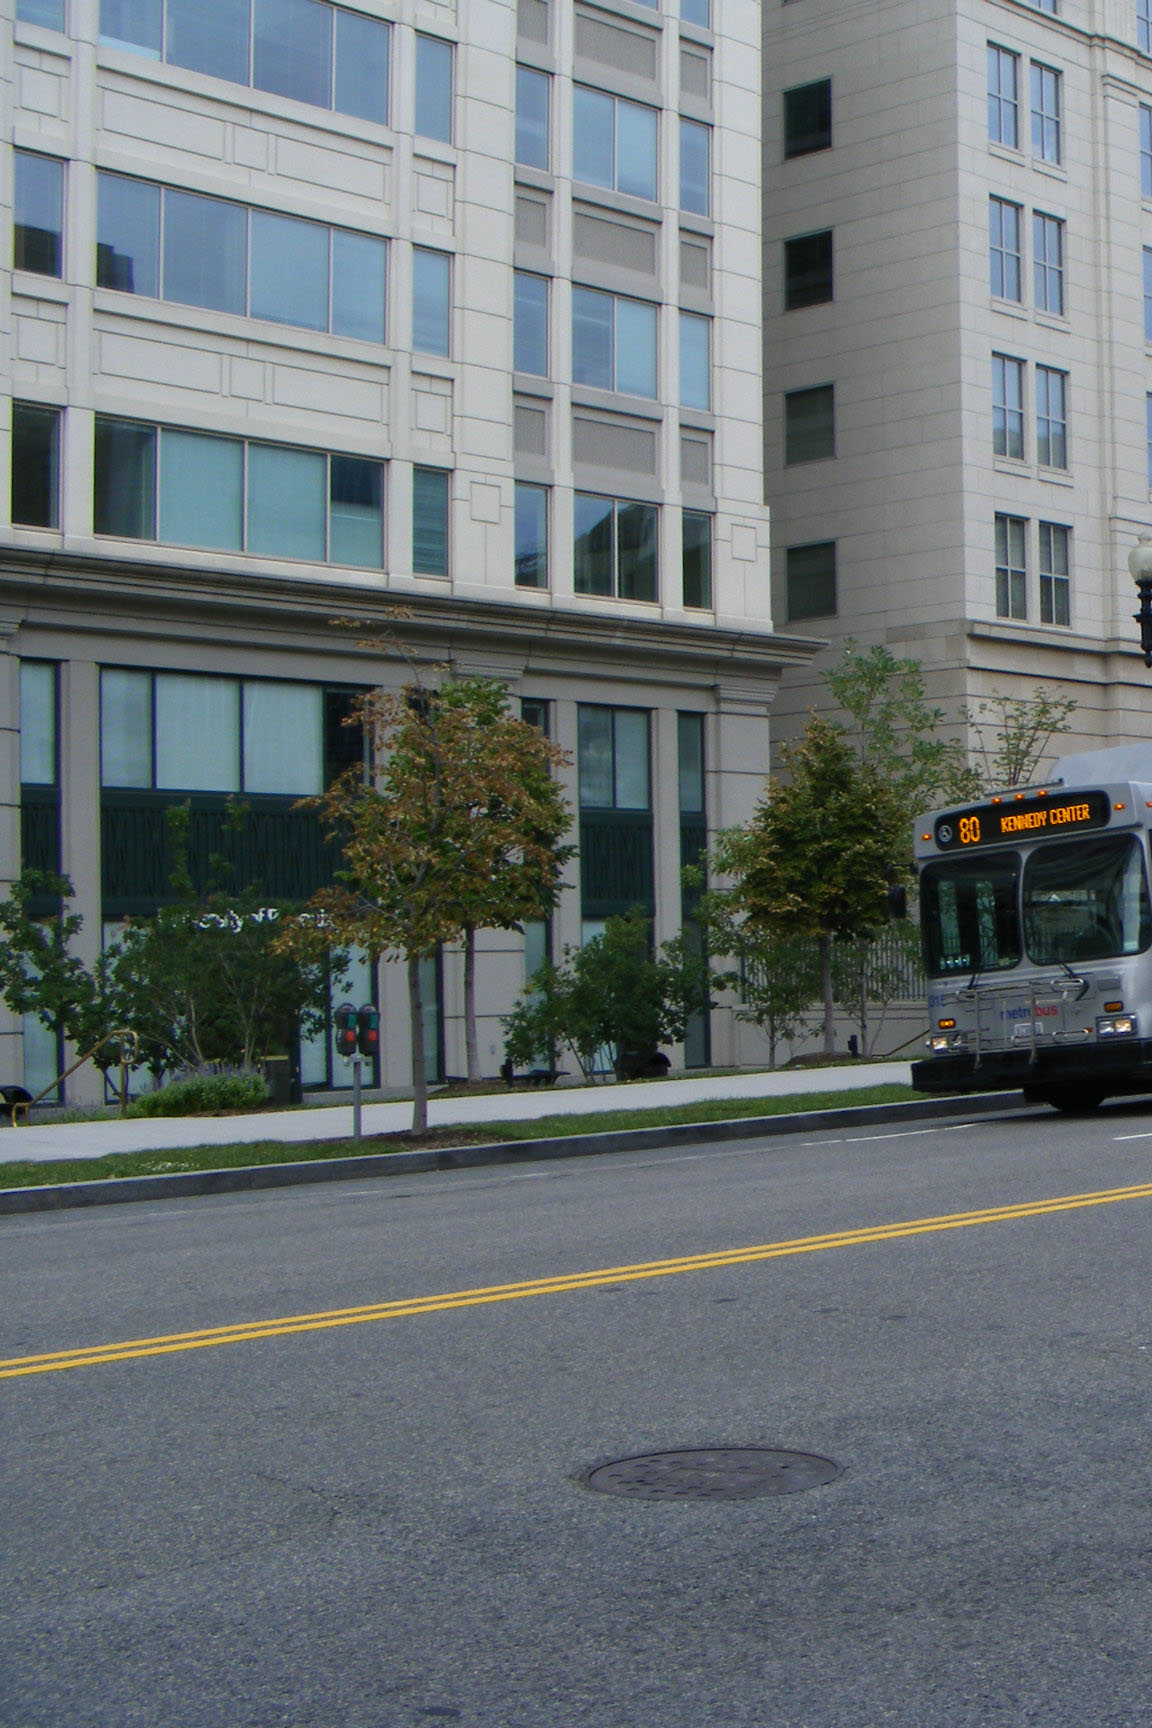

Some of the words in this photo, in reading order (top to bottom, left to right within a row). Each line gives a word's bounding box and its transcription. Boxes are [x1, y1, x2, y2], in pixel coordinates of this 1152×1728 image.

[959, 816, 981, 844] 80
[1001, 810, 1047, 833] KENNEDY
[1050, 803, 1091, 825] CENTER
